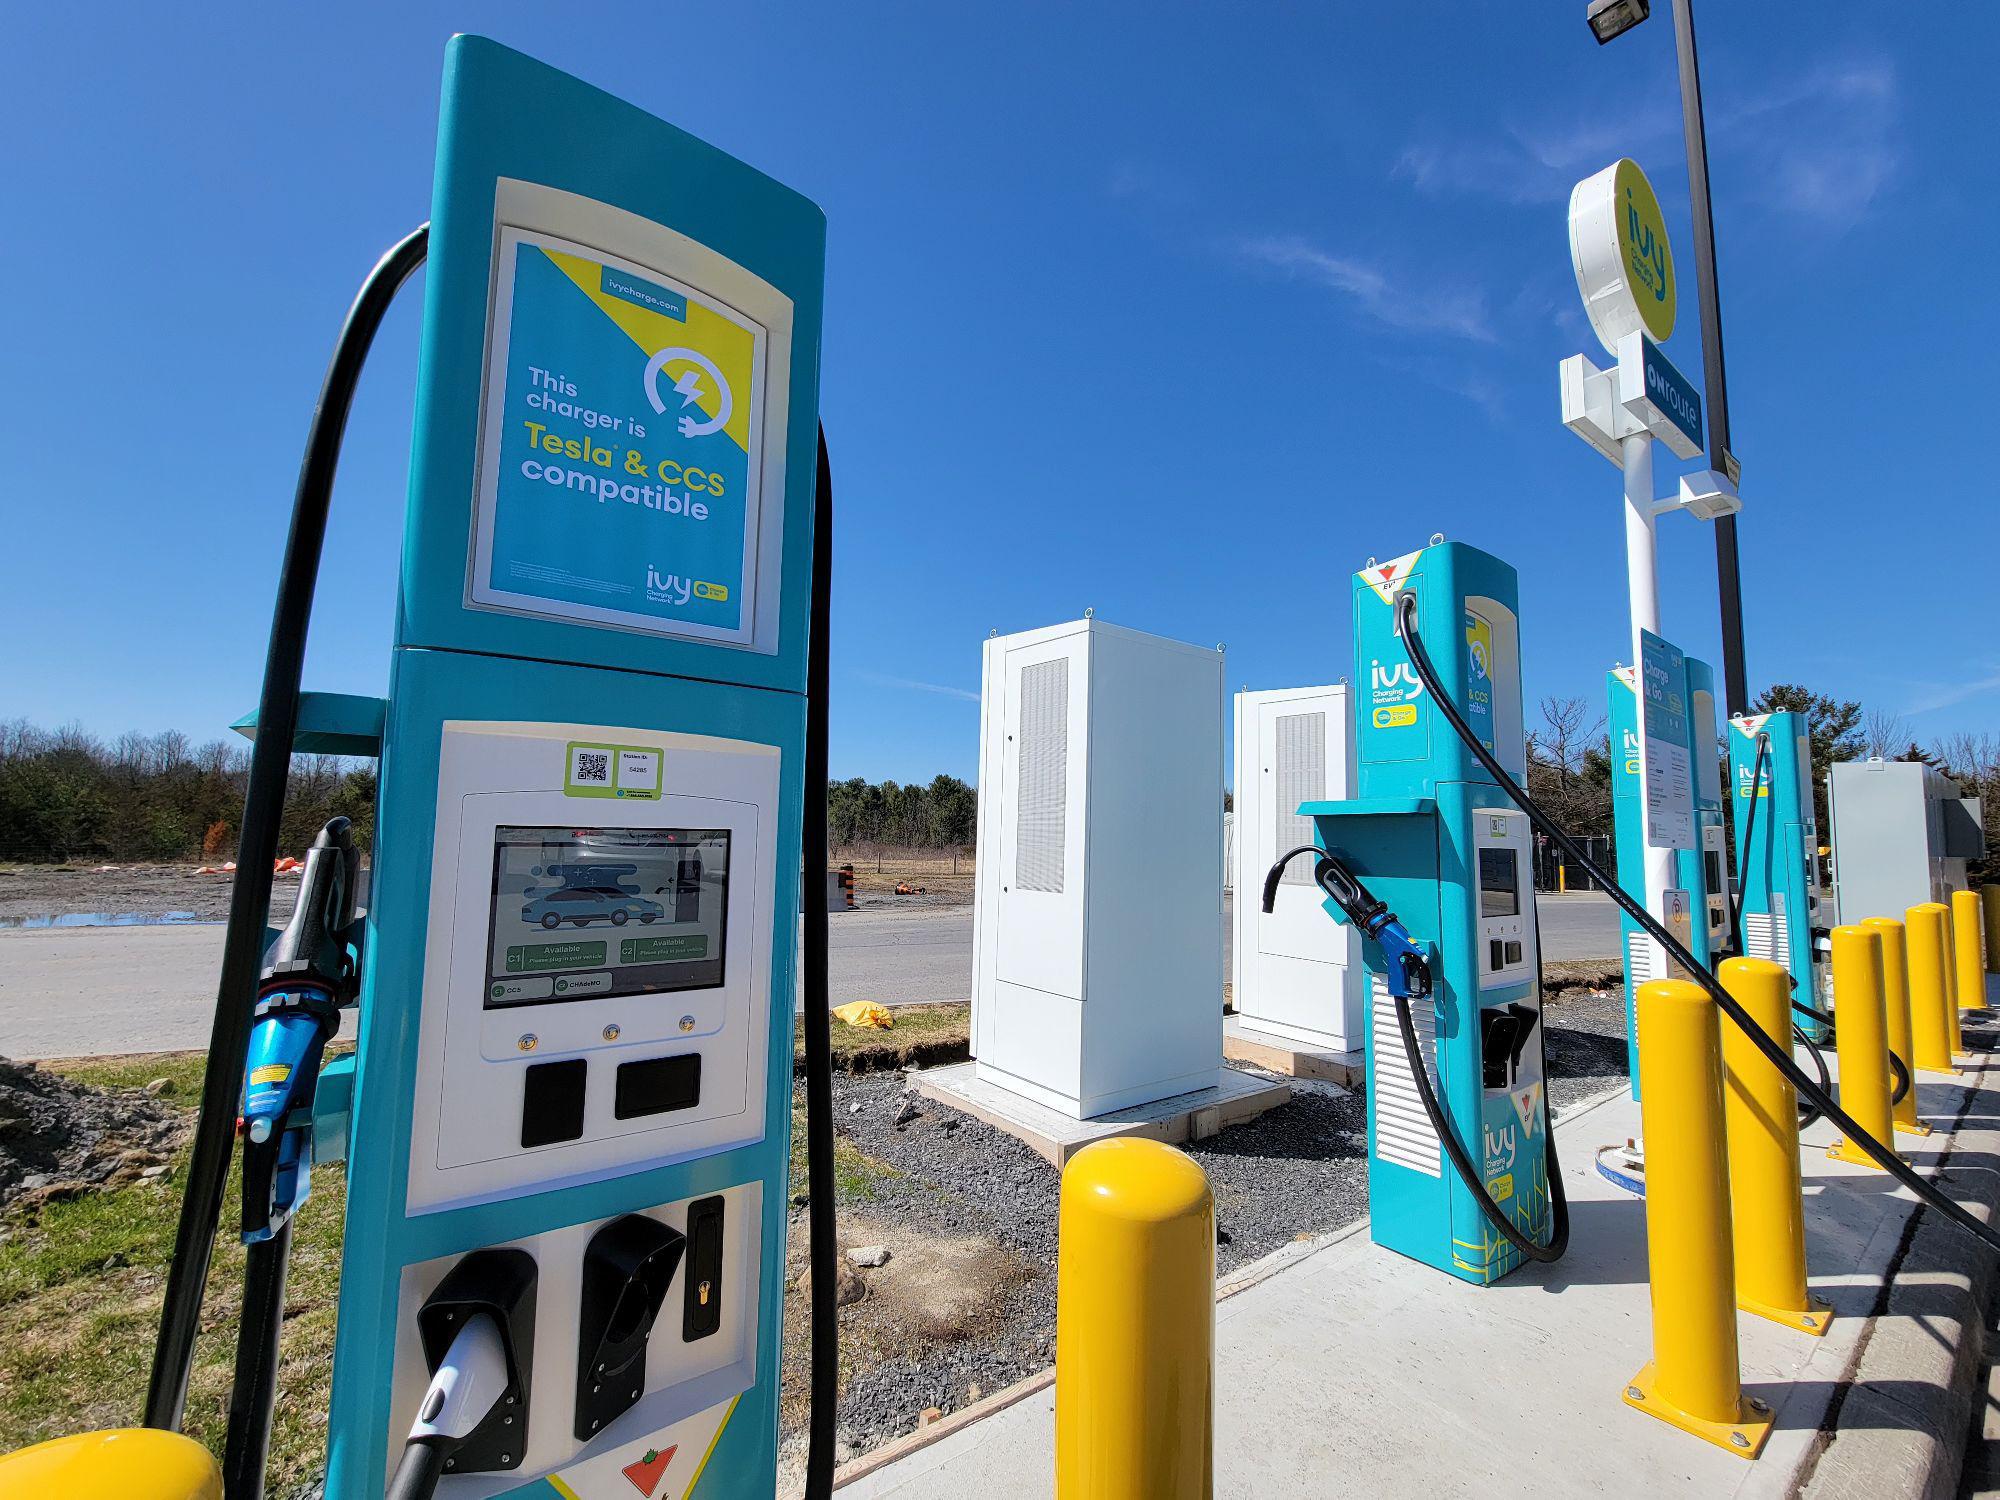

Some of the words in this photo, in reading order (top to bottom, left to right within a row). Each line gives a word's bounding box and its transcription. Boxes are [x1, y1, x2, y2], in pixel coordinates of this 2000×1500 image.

[1626, 187, 1666, 302] ivy
[609, 279, 679, 313] ivycharge.com
[528, 366, 578, 397] This
[526, 392, 622, 429] charger
[628, 417, 646, 438] is
[624, 449, 649, 478] &
[657, 460, 725, 497] CCS
[521, 460, 709, 521] compatible
[647, 564, 691, 605] ivy
[647, 589, 673, 599] Charging
[647, 595, 672, 604] Network
[1644, 658, 1669, 685] Charge
[1371, 660, 1424, 700] ivy
[1372, 688, 1404, 697] Charging
[1475, 690, 1489, 704] CCS
[1652, 683, 1662, 701] Go
[1372, 695, 1402, 705] Network
[1469, 702, 1486, 715] atible
[543, 945, 581, 954] Available
[652, 939, 685, 947] Available
[621, 947, 634, 956] C2
[507, 954, 520, 964] C1
[569, 980, 601, 989] CHAdeMO
[1485, 1123, 1516, 1169] ivy
[1486, 1157, 1505, 1169] Charging
[1486, 1168, 1505, 1177] Network
